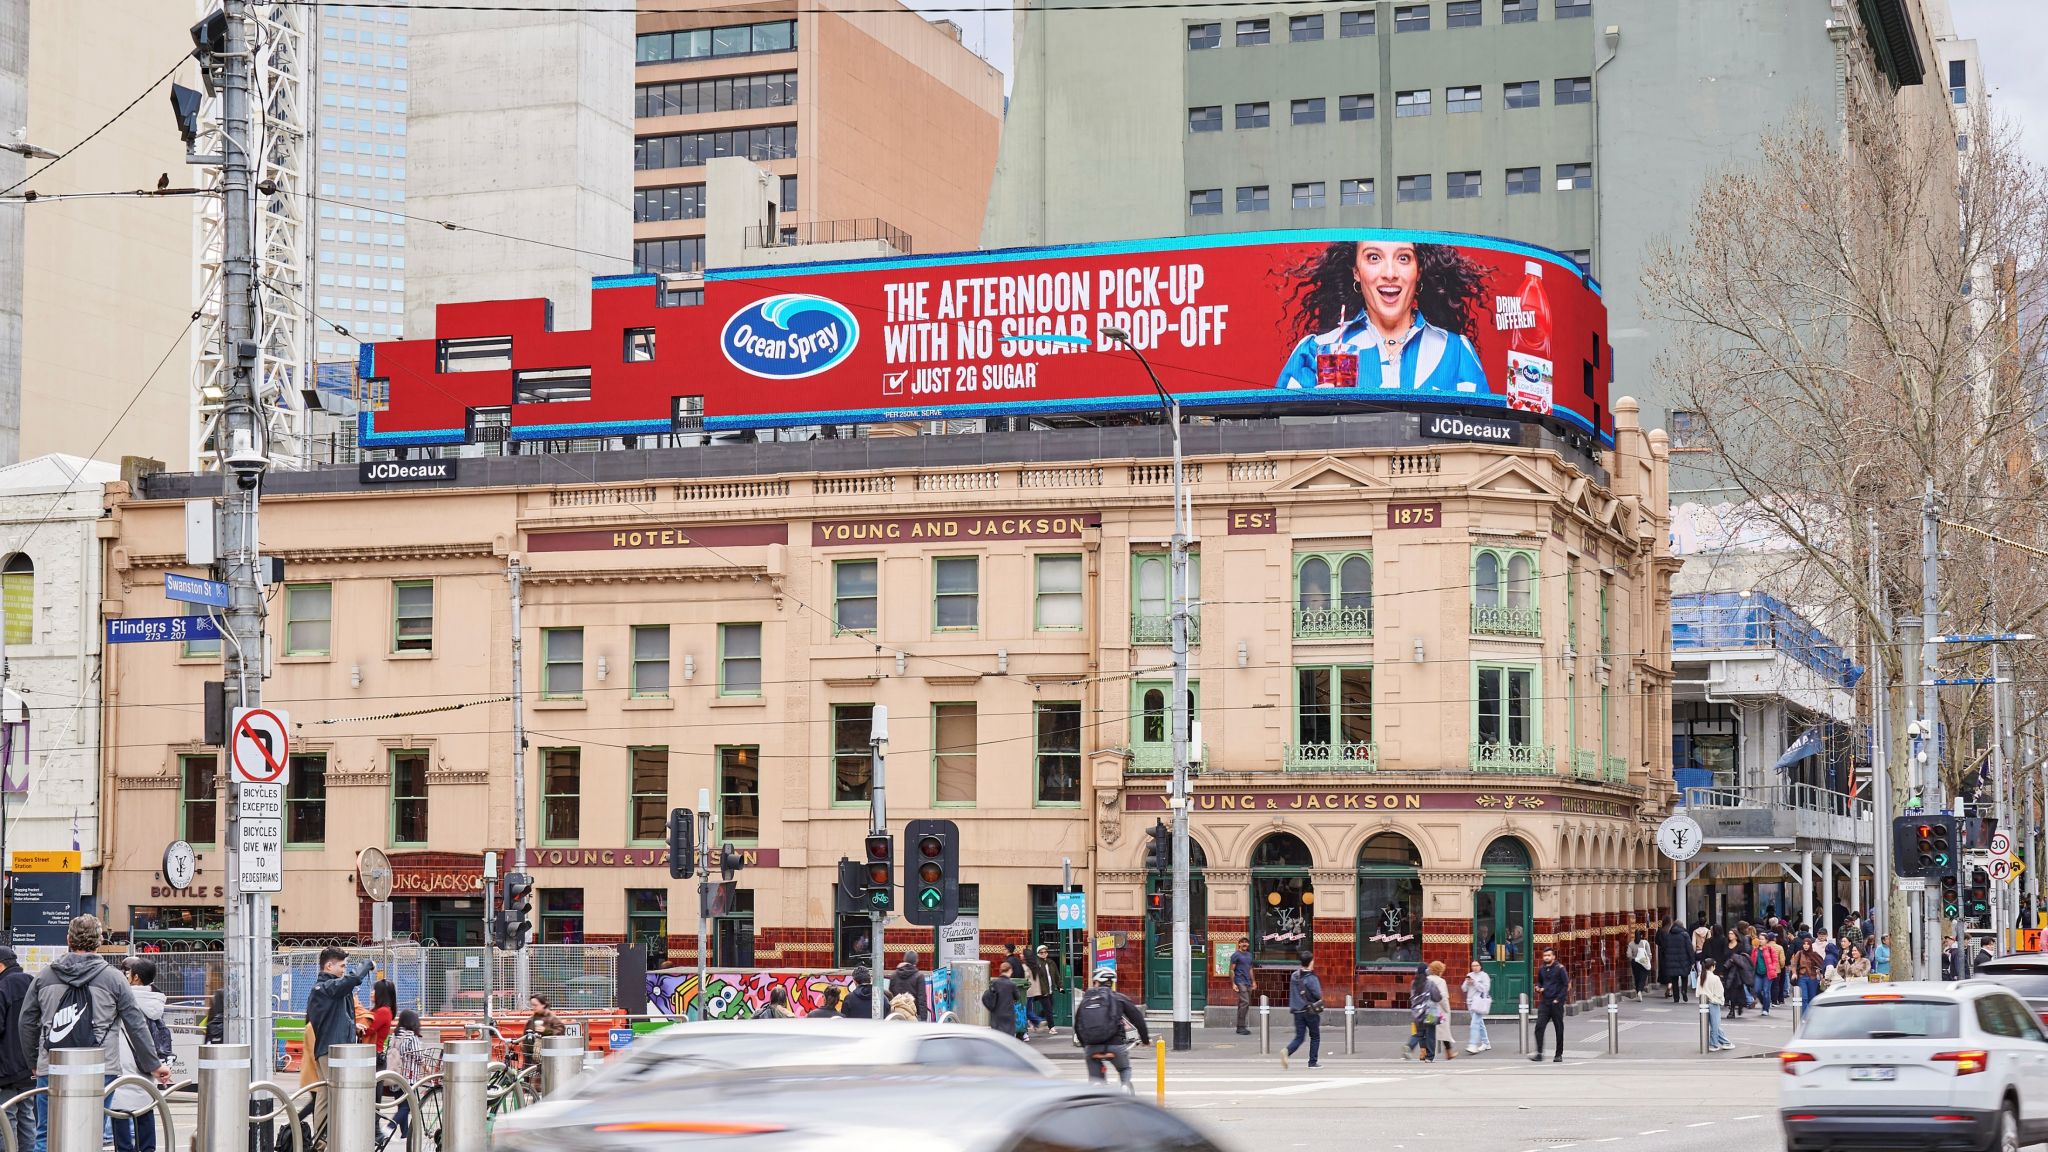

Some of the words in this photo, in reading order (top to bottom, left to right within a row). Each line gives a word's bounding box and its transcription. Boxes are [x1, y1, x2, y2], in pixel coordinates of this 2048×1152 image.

[883, 282, 929, 323] THE
[938, 270, 1091, 319] AFTERNOON
[1098, 263, 1205, 309] PICK-UP
[1495, 295, 1522, 313] DRINK
[1495, 310, 1536, 330] DIFFERENT
[733, 324, 787, 359] Ocean
[788, 321, 840, 363] Spray
[884, 323, 948, 364] WITH
[956, 320, 994, 361] NO
[1001, 315, 1090, 358] SUGAR
[1097, 304, 1229, 352] DROP-OFF
[911, 367, 952, 394] JUST
[955, 366, 978, 390] 2G
[921, 409, 943, 417] SERVE
[1430, 417, 1511, 440] JCDecaux
[367, 463, 447, 479] JCDecaux
[1394, 507, 1435, 525] 1875
[821, 523, 901, 540] YOUNG
[911, 521, 959, 537] AND
[967, 517, 1085, 536] JACKSON
[612, 530, 691, 547] HOTEL
[167, 576, 203, 595] Swanston
[203, 581, 212, 597] St
[111, 619, 167, 635] Flinders
[171, 617, 187, 632] St
[145, 632, 161, 641] 273
[170, 631, 187, 640] 207
[243, 788, 278, 798] BICYCLES
[242, 802, 279, 812] EXCEPTED
[1159, 794, 1256, 810] YUNG
[1266, 799, 1278, 809] &
[1290, 794, 1421, 809] JACKSON
[1561, 797, 1584, 812] PRINCES
[243, 826, 277, 837] BICYCLES
[243, 841, 260, 852] GIVE
[263, 841, 278, 852] WAY
[1991, 840, 2006, 849] 30
[255, 857, 266, 868] TO
[533, 850, 615, 865] YOUNG
[623, 854, 634, 865] &
[642, 850, 757, 865] JASN
[241, 872, 279, 883] PEDESTRIANS
[942, 926, 978, 939] Function
[52, 1002, 78, 1029] NIKE
